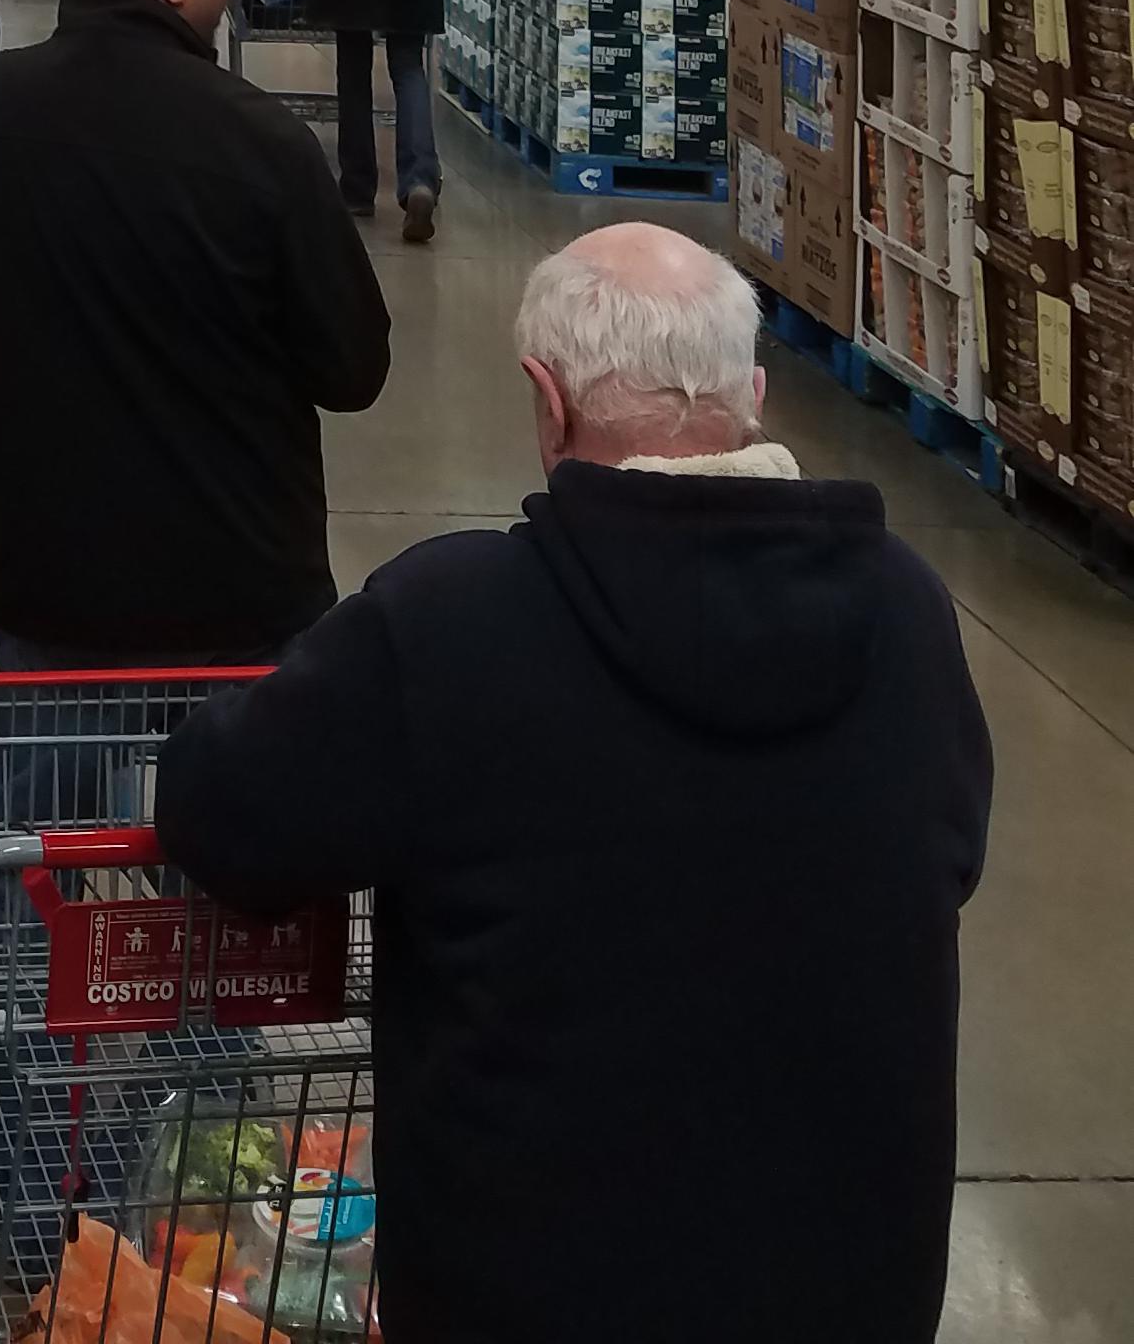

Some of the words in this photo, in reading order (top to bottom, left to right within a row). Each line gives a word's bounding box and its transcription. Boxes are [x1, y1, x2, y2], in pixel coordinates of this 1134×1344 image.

[593, 48, 631, 58] BREAKFAST
[678, 52, 716, 62] BREAKFAST
[593, 56, 615, 66] BLEND
[678, 60, 700, 70] BLEND
[733, 73, 764, 105] MATZOS
[593, 109, 632, 119] BREAKFAST
[677, 114, 716, 124] BREAKFAST
[593, 117, 615, 127] BLEND
[677, 123, 700, 133] BLEND
[801, 244, 838, 281] MATZOS
[92, 922, 105, 982] WARNING
[87, 981, 175, 1004] COSTCO
